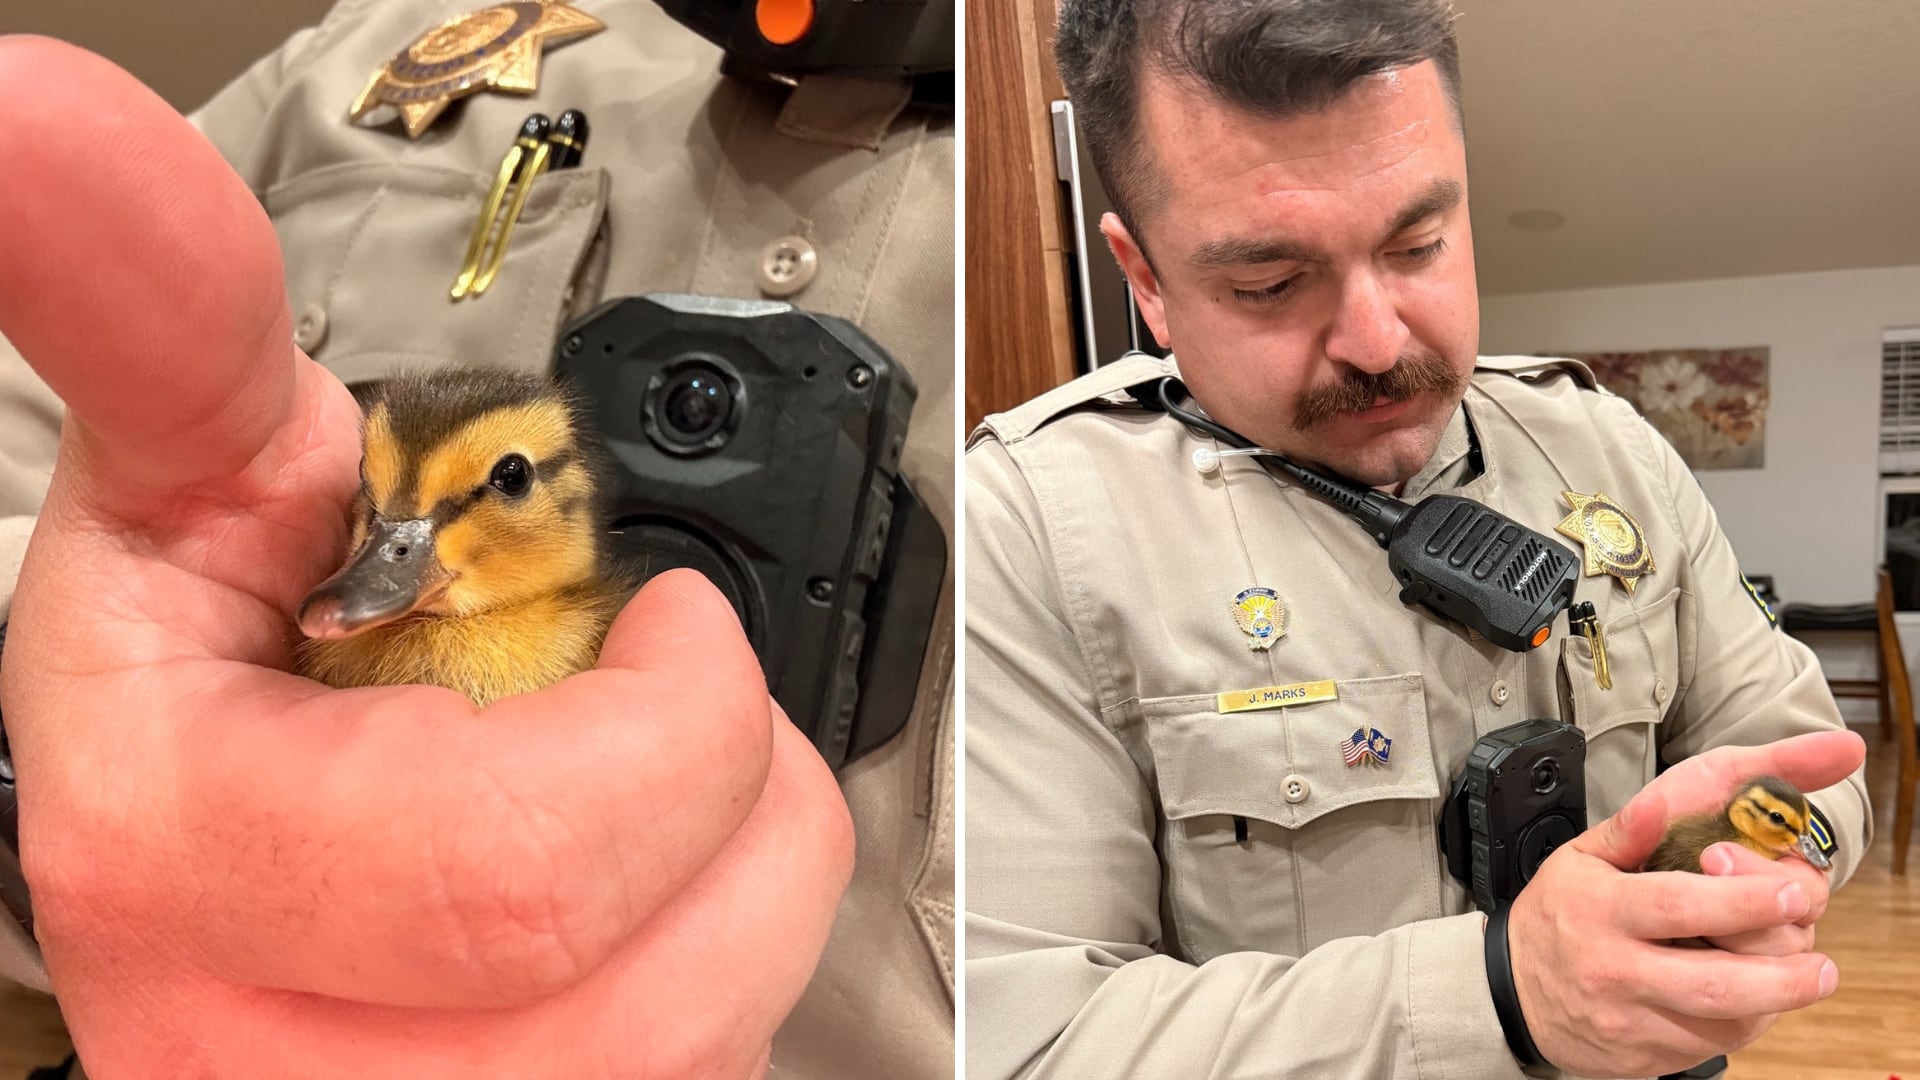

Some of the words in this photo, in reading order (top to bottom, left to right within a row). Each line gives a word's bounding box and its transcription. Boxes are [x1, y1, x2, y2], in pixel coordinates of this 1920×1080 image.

[1515, 551, 1547, 590] MOTOROLA
[1249, 694, 1259, 704] J.
[1264, 687, 1306, 701] MARKS
